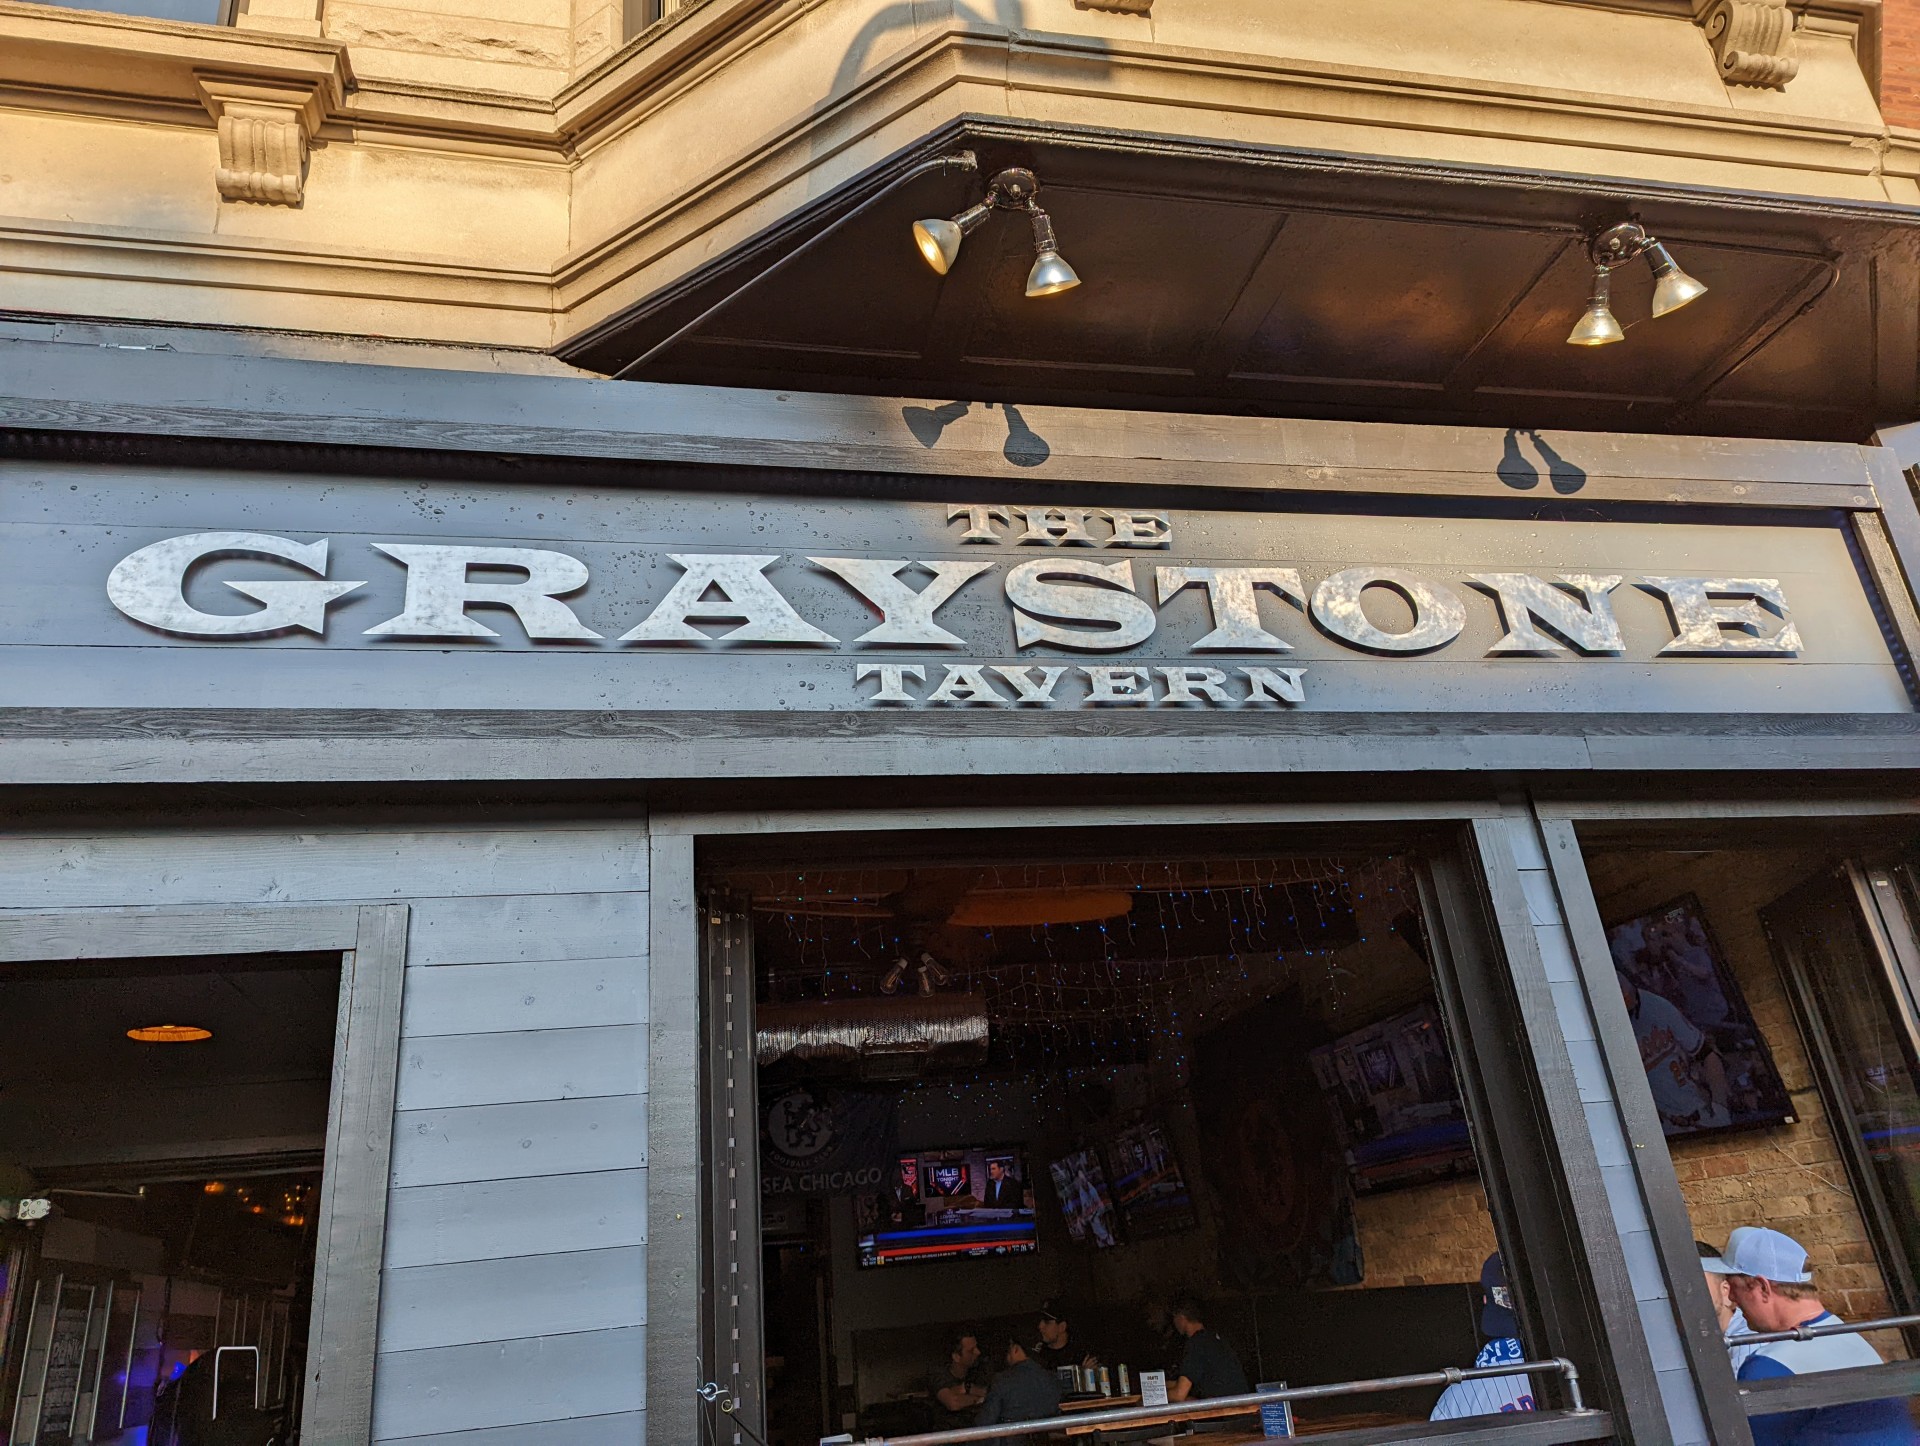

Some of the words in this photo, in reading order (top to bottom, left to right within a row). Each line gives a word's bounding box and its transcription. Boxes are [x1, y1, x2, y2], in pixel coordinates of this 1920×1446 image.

[946, 503, 1173, 545] THE
[107, 531, 1804, 656] GRAYSTONE
[855, 663, 1309, 704] TAVERN
[799, 1167, 882, 1192] CHICAGO
[935, 1167, 959, 1178] MLB
